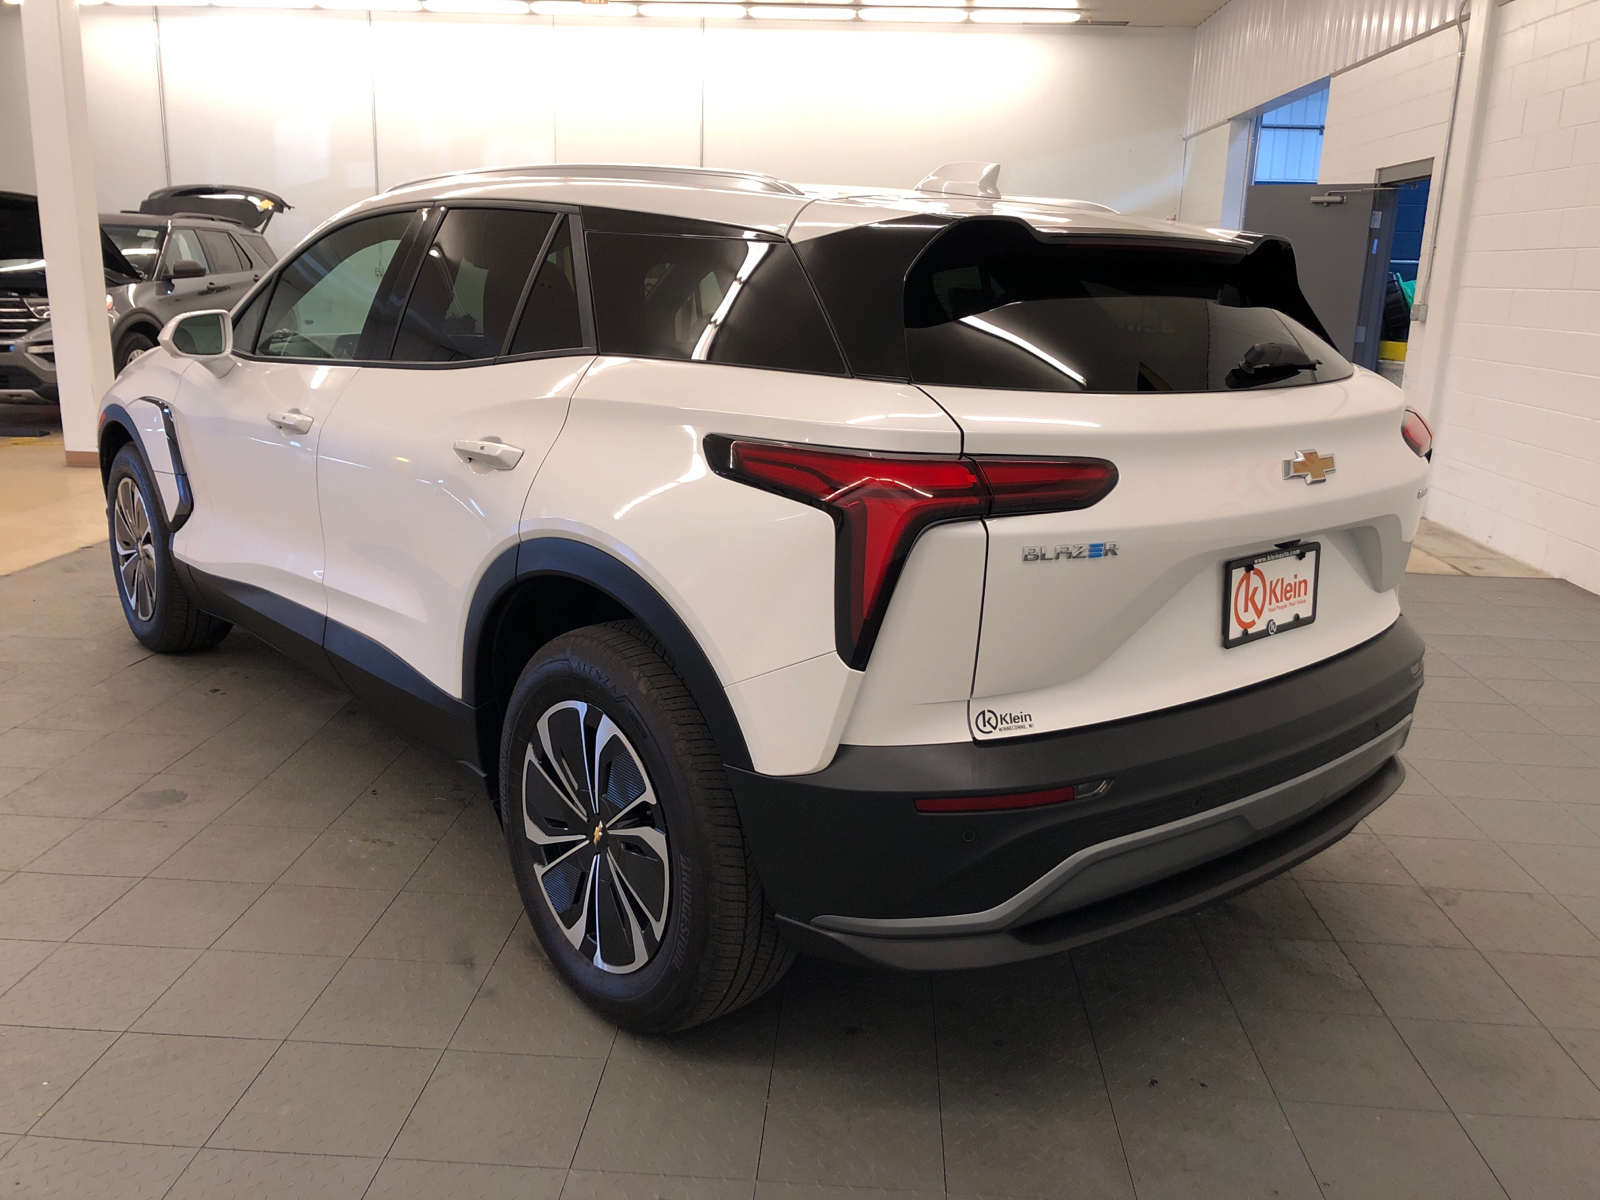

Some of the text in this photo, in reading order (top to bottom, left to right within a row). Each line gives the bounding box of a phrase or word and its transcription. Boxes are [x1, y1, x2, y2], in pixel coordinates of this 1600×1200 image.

[1022, 541, 1119, 562] BLAZER
[1268, 574, 1308, 605] Klein
[575, 661, 617, 694] ALENZA
[999, 711, 1033, 726] Klein
[672, 854, 692, 971] BRIDGESTONE
